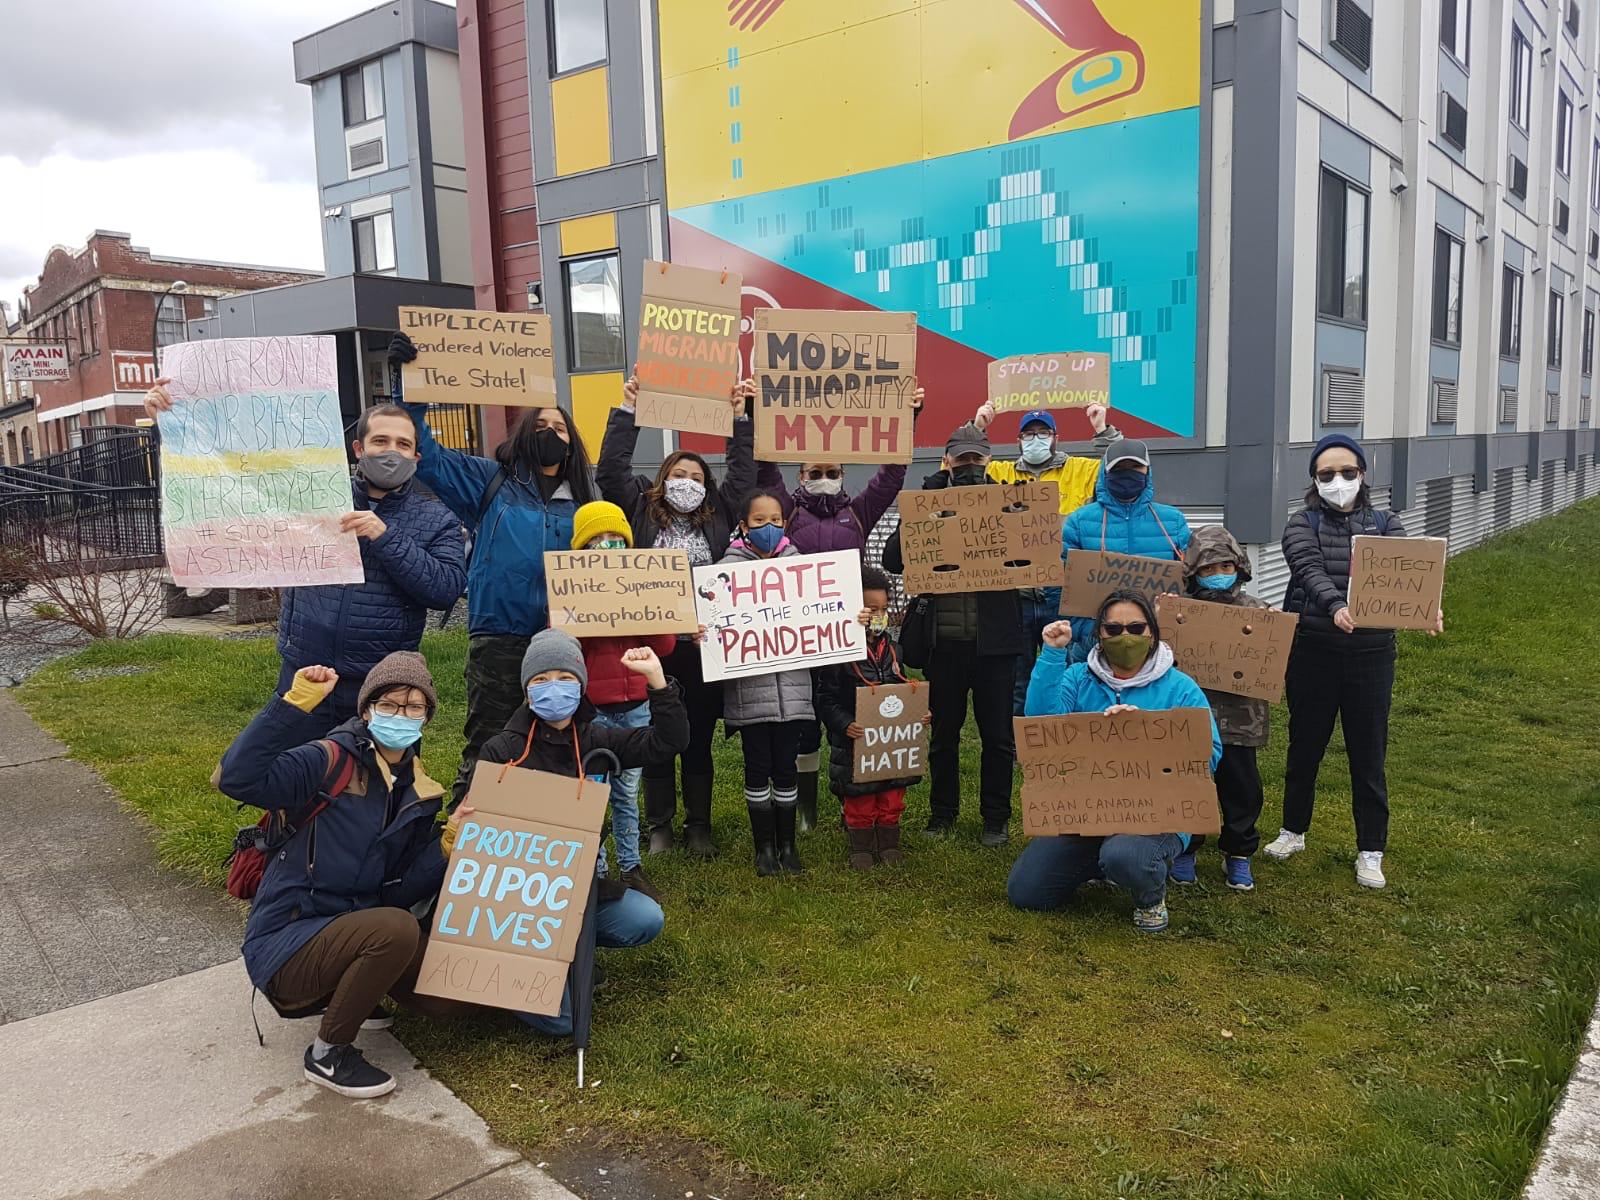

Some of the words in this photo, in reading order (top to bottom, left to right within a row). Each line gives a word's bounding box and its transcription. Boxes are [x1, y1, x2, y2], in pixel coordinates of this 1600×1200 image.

[402, 310, 538, 337] IMPLICATE
[641, 302, 736, 337] PROTECT
[10, 348, 64, 361] MAIN
[489, 340, 553, 358] Violence
[639, 330, 738, 365] MIGRANT
[765, 332, 900, 371] MODEL
[34, 368, 69, 378] STORAGE
[418, 366, 461, 388] The
[467, 367, 527, 393] State!
[997, 358, 1060, 379] STAND
[1071, 357, 1096, 372] UP
[760, 373, 913, 410] MINORITY
[1027, 374, 1068, 391] FOR
[994, 390, 1041, 412] BIPOC
[1046, 389, 1109, 405] WOMEN
[170, 394, 248, 455] YOUR
[252, 393, 330, 450] BIASES
[641, 399, 698, 428] ACLA
[774, 414, 900, 453] MYTH
[165, 470, 348, 523] STEREOTYPES
[914, 491, 989, 512] RACISM
[1002, 486, 1051, 502] KILLS
[905, 519, 946, 537] STOP
[959, 515, 1005, 534] BLACK
[1021, 512, 1059, 528] LAND
[905, 536, 941, 551] ASIAN
[963, 531, 1008, 548] LIVES
[1021, 529, 1061, 549] BACK
[184, 545, 269, 576] ASIAN
[280, 544, 338, 572] HATE
[551, 553, 686, 572] IMPLICATE
[908, 549, 945, 565] HATE
[963, 546, 1008, 561] MATTER
[1361, 547, 1437, 573] PROTECT
[905, 573, 944, 583] ASIAN
[947, 569, 1010, 581] CANADIAN
[1035, 564, 1060, 583] BC
[1104, 556, 1177, 578] WHITE
[551, 577, 611, 598] White
[615, 576, 686, 599] Supremacy
[729, 561, 842, 607] HATE
[907, 581, 959, 593] LABOUR
[965, 577, 1015, 589] ALLIANCE
[1361, 573, 1424, 593] ASIAN
[562, 605, 684, 629] Xenophobia
[720, 611, 754, 629] IS
[757, 604, 792, 623] THE
[802, 600, 845, 617] OTHER
[1355, 595, 1434, 621] WOMEN
[721, 619, 856, 664] PANDEMIC
[864, 721, 923, 747] DUMP
[1023, 722, 1079, 749] END
[1089, 718, 1191, 744] RACISM
[861, 747, 920, 774] HATE
[1024, 760, 1079, 783] STOP
[1090, 759, 1151, 780] ASIAN
[1176, 759, 1210, 780] HATE
[1028, 800, 1077, 814] ASIAN
[1085, 797, 1154, 810] CANADIAN
[1181, 799, 1212, 820] BC
[1029, 813, 1090, 828] LABOUR
[1095, 812, 1160, 825] ALLIANCE
[456, 821, 583, 869] PROTECT
[448, 858, 574, 911] BIPOC
[438, 902, 562, 950] LIVES
[427, 953, 500, 996] ACLA
[512, 977, 527, 991] IN
[525, 971, 562, 1007] BC
